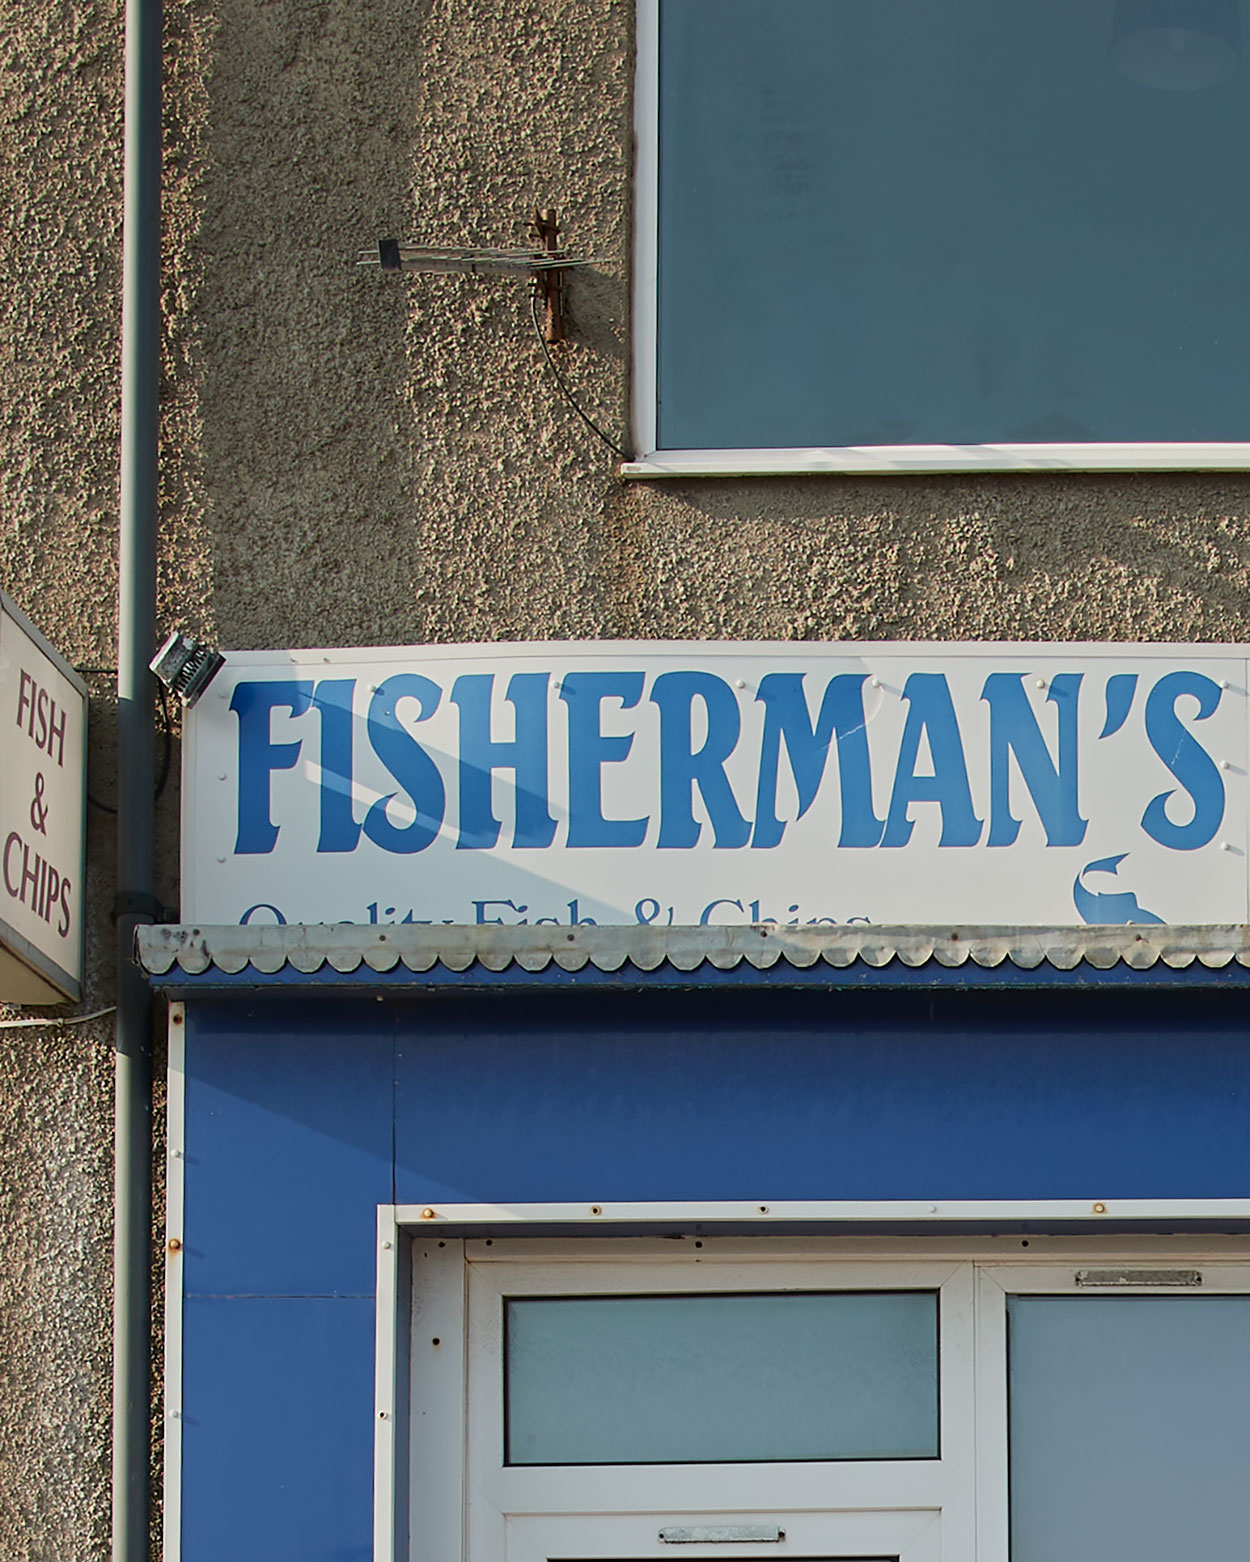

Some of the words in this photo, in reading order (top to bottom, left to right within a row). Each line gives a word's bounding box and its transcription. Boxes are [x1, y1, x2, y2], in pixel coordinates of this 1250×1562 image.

[16, 668, 67, 768] FISH
[228, 670, 1226, 855] FISHERMAN'S
[30, 772, 48, 836] &
[3, 831, 72, 939] CHIPS
